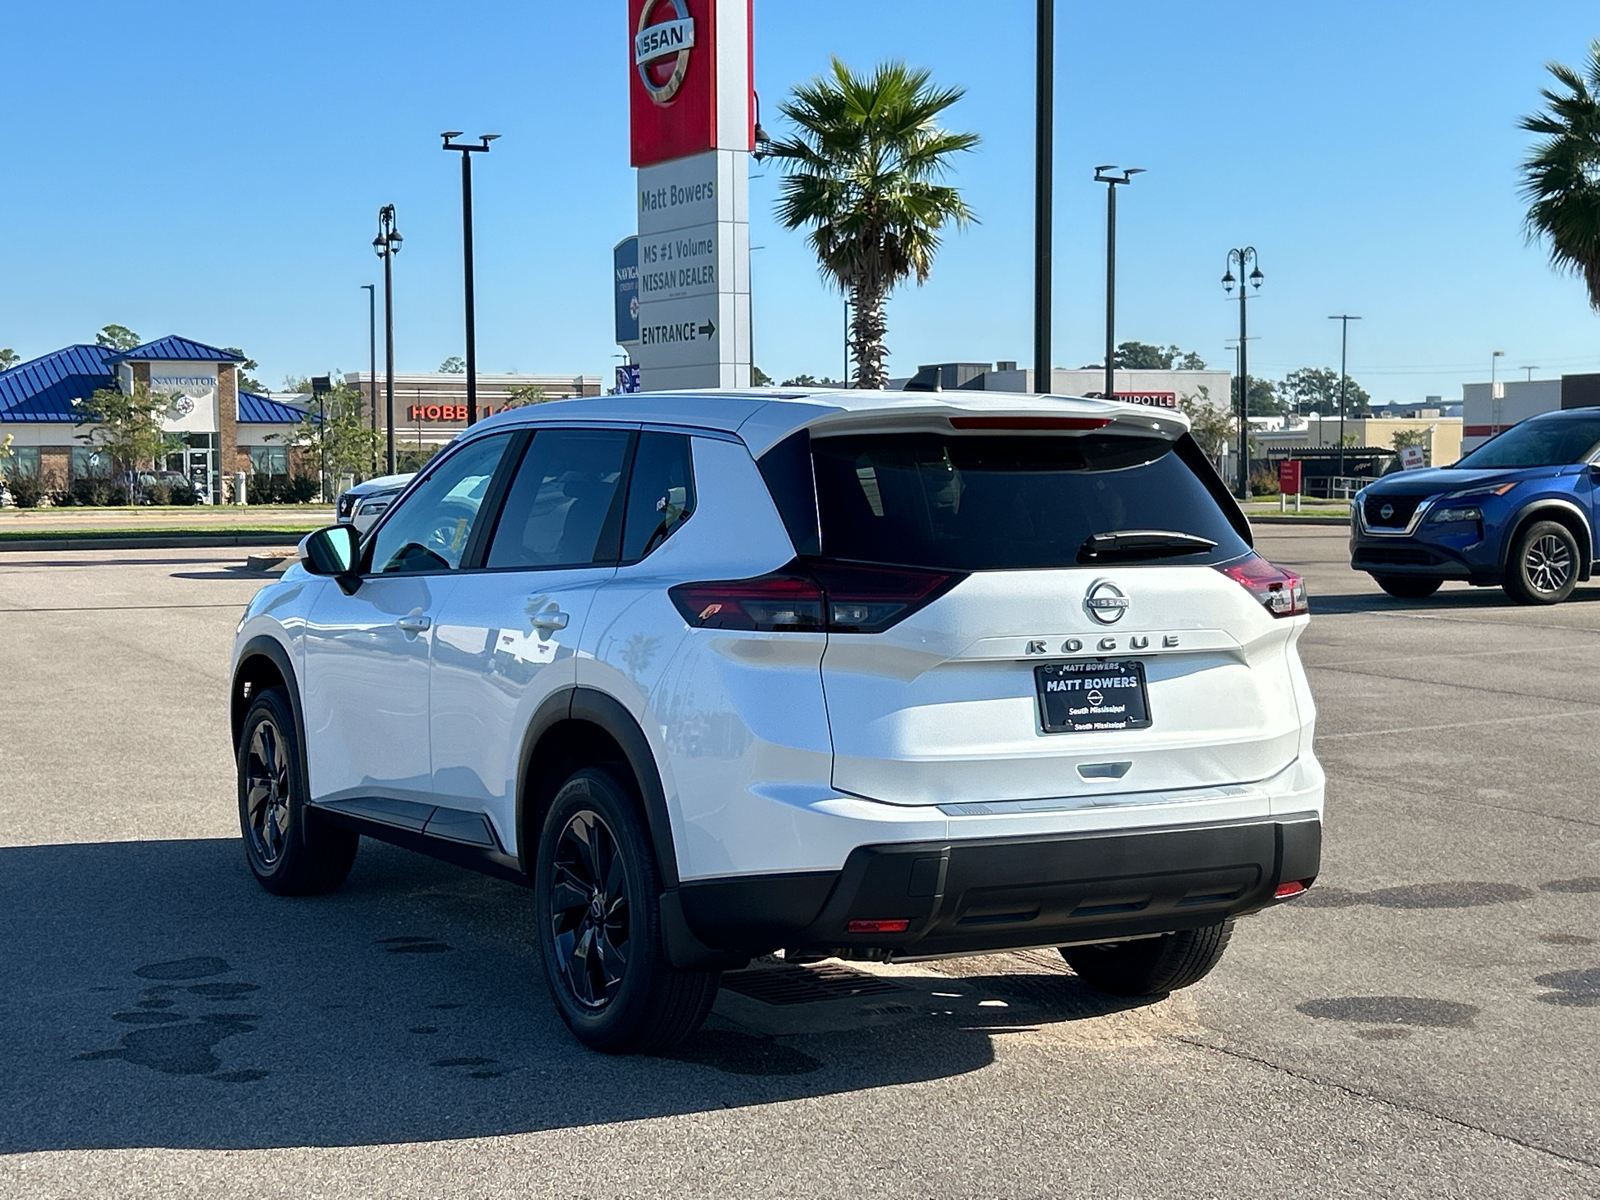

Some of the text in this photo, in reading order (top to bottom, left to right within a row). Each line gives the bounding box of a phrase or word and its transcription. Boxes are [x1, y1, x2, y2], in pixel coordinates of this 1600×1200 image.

[636, 25, 683, 57] NISSAN
[641, 181, 714, 212] Matt Bowers
[643, 238, 713, 264] MS #1 Volume
[616, 266, 639, 281] NAVIGA
[642, 270, 676, 292] NISSAN
[679, 265, 715, 287] DEALER
[642, 322, 696, 345] ENTRANCE
[152, 376, 217, 386] NAVIGATOR
[1119, 395, 1173, 406] IPOTLE
[412, 404, 481, 419] HOBB
[1087, 599, 1128, 608] NISSAN
[1027, 635, 1180, 654] ROGUE
[1062, 662, 1119, 672] MATT BOWERS
[1047, 676, 1137, 692] MATT BOWERS
[1068, 704, 1125, 715] South Mississippi
